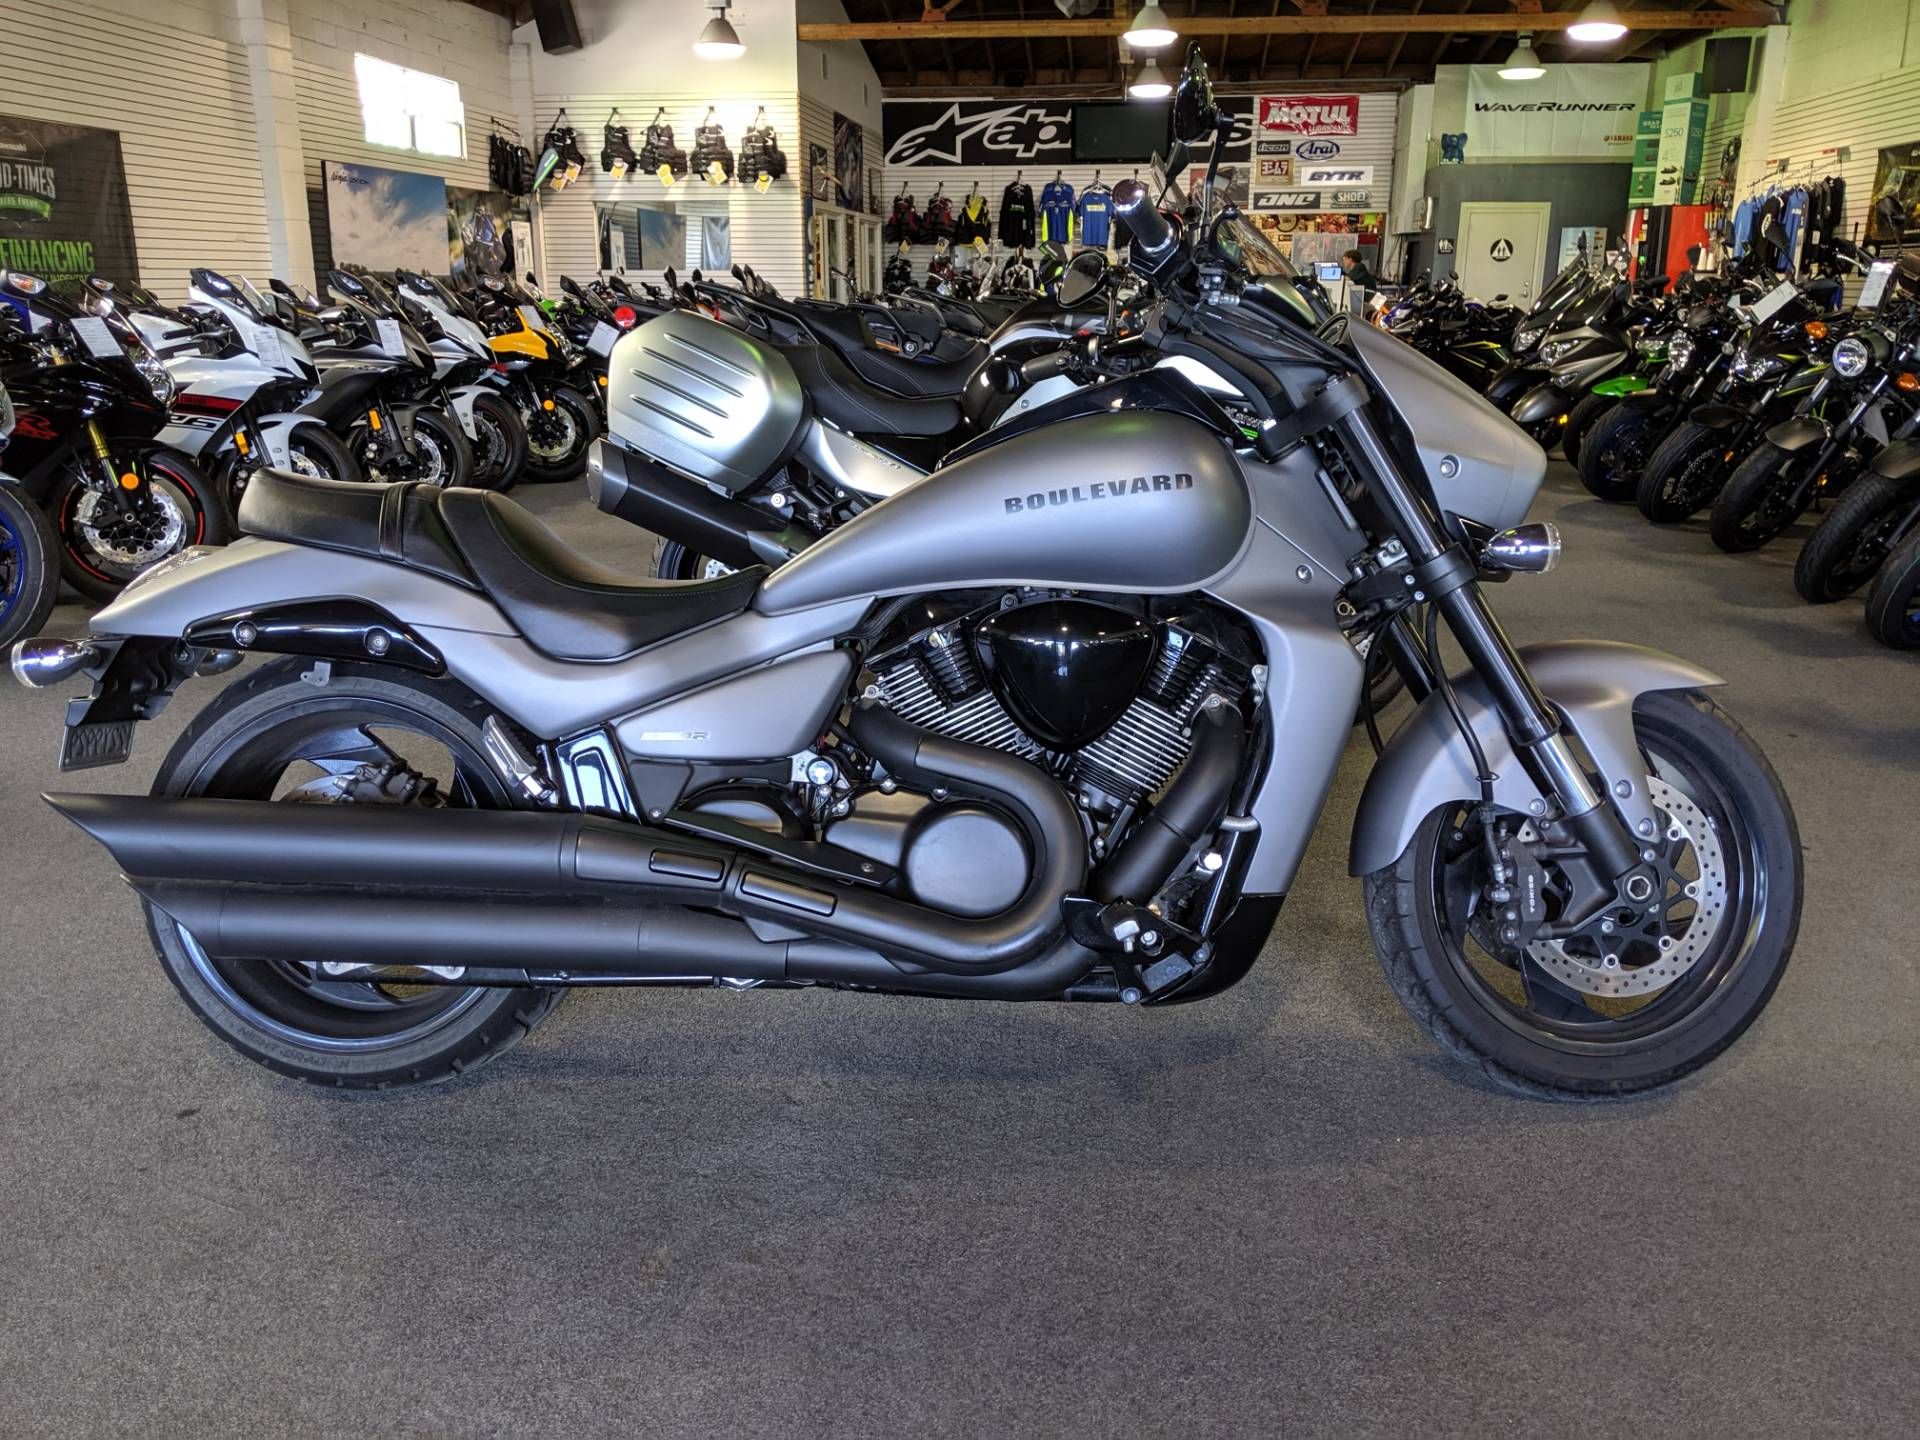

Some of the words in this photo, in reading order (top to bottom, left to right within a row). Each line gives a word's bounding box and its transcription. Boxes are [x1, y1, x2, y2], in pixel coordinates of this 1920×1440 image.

[1266, 105, 1351, 124] MOTUL
[1300, 142, 1335, 155] Arai
[1337, 193, 1366, 202] SHOEI
[0, 238, 95, 272] FINANCING
[1004, 473, 1194, 514] BOULEVARD
